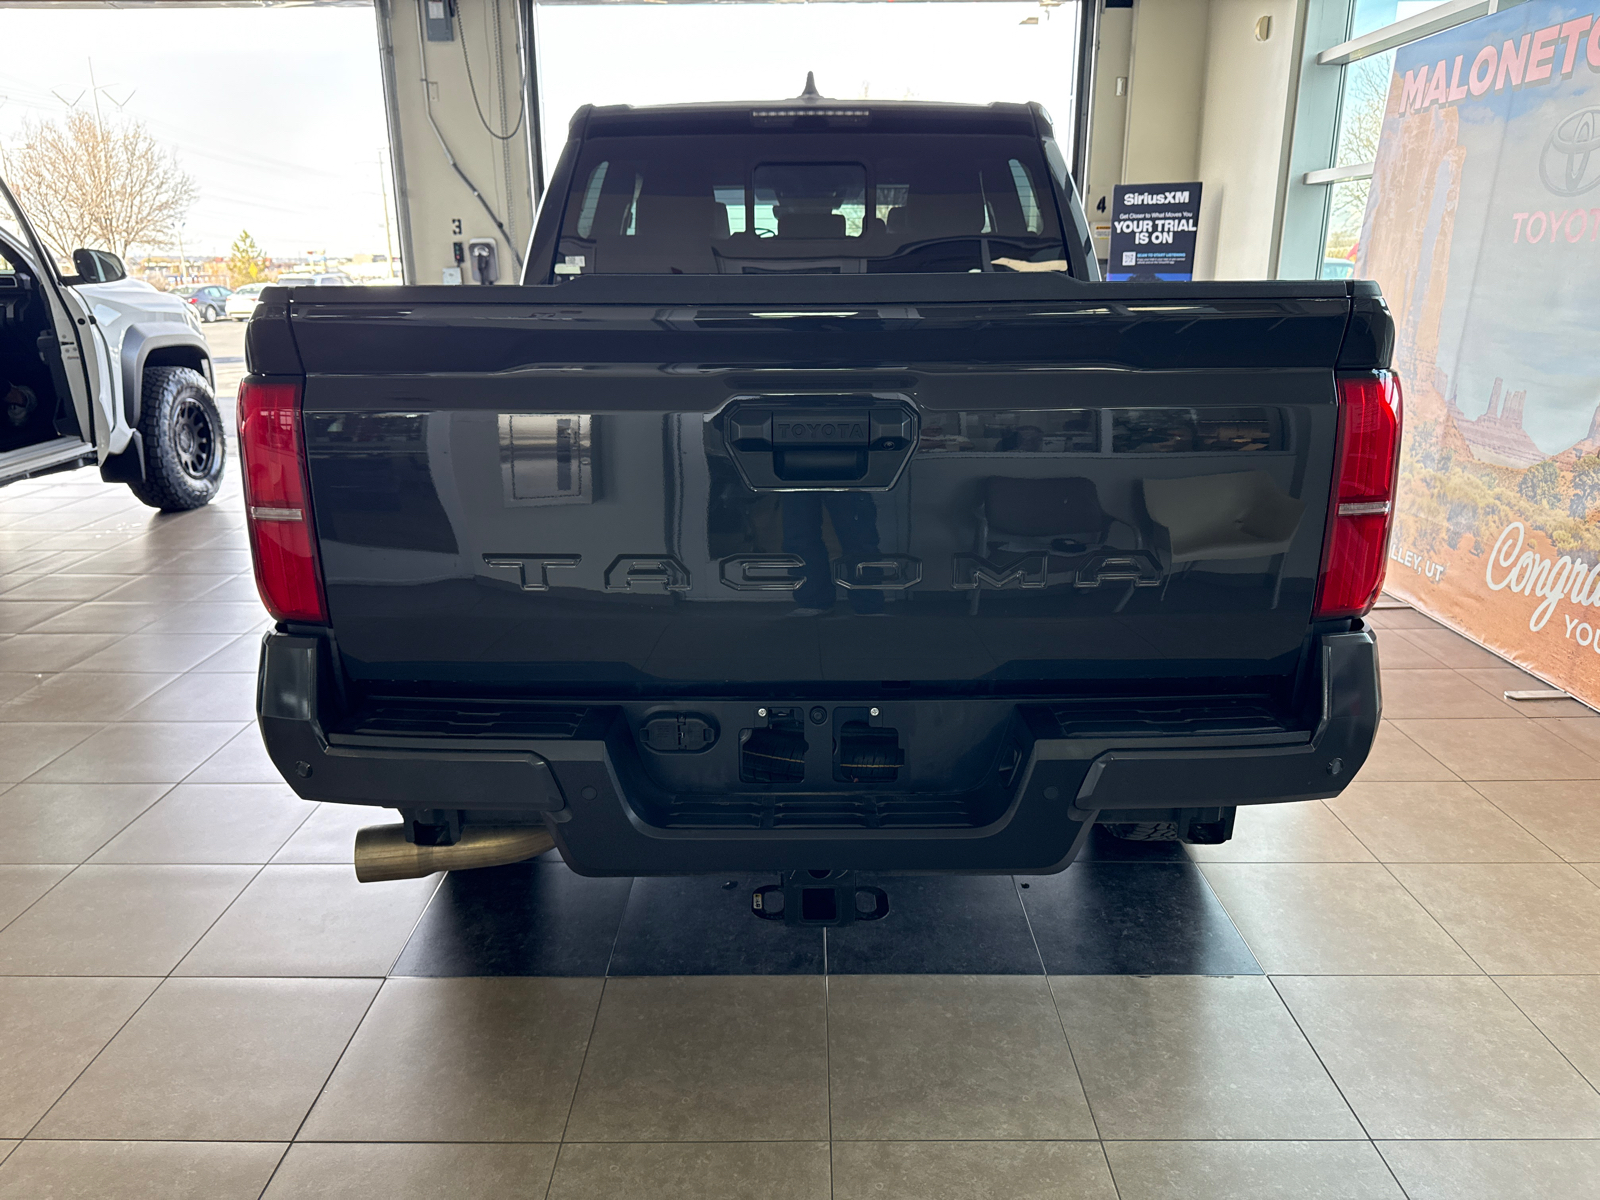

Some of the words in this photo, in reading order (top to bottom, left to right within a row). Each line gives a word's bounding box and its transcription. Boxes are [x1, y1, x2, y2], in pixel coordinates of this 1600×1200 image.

[1096, 196, 1106, 213] 4
[1123, 191, 1190, 206] SiriusXM
[452, 219, 462, 235] 3
[1114, 220, 1153, 233] YOUR
[1155, 219, 1197, 232] TRIAL
[1135, 232, 1150, 244] IS
[1151, 232, 1174, 244] ON
[777, 423, 864, 439] TOYOTA
[1389, 543, 1422, 575] LLEY,
[1425, 560, 1444, 581] UT
[481, 552, 1164, 592] TACOMA
